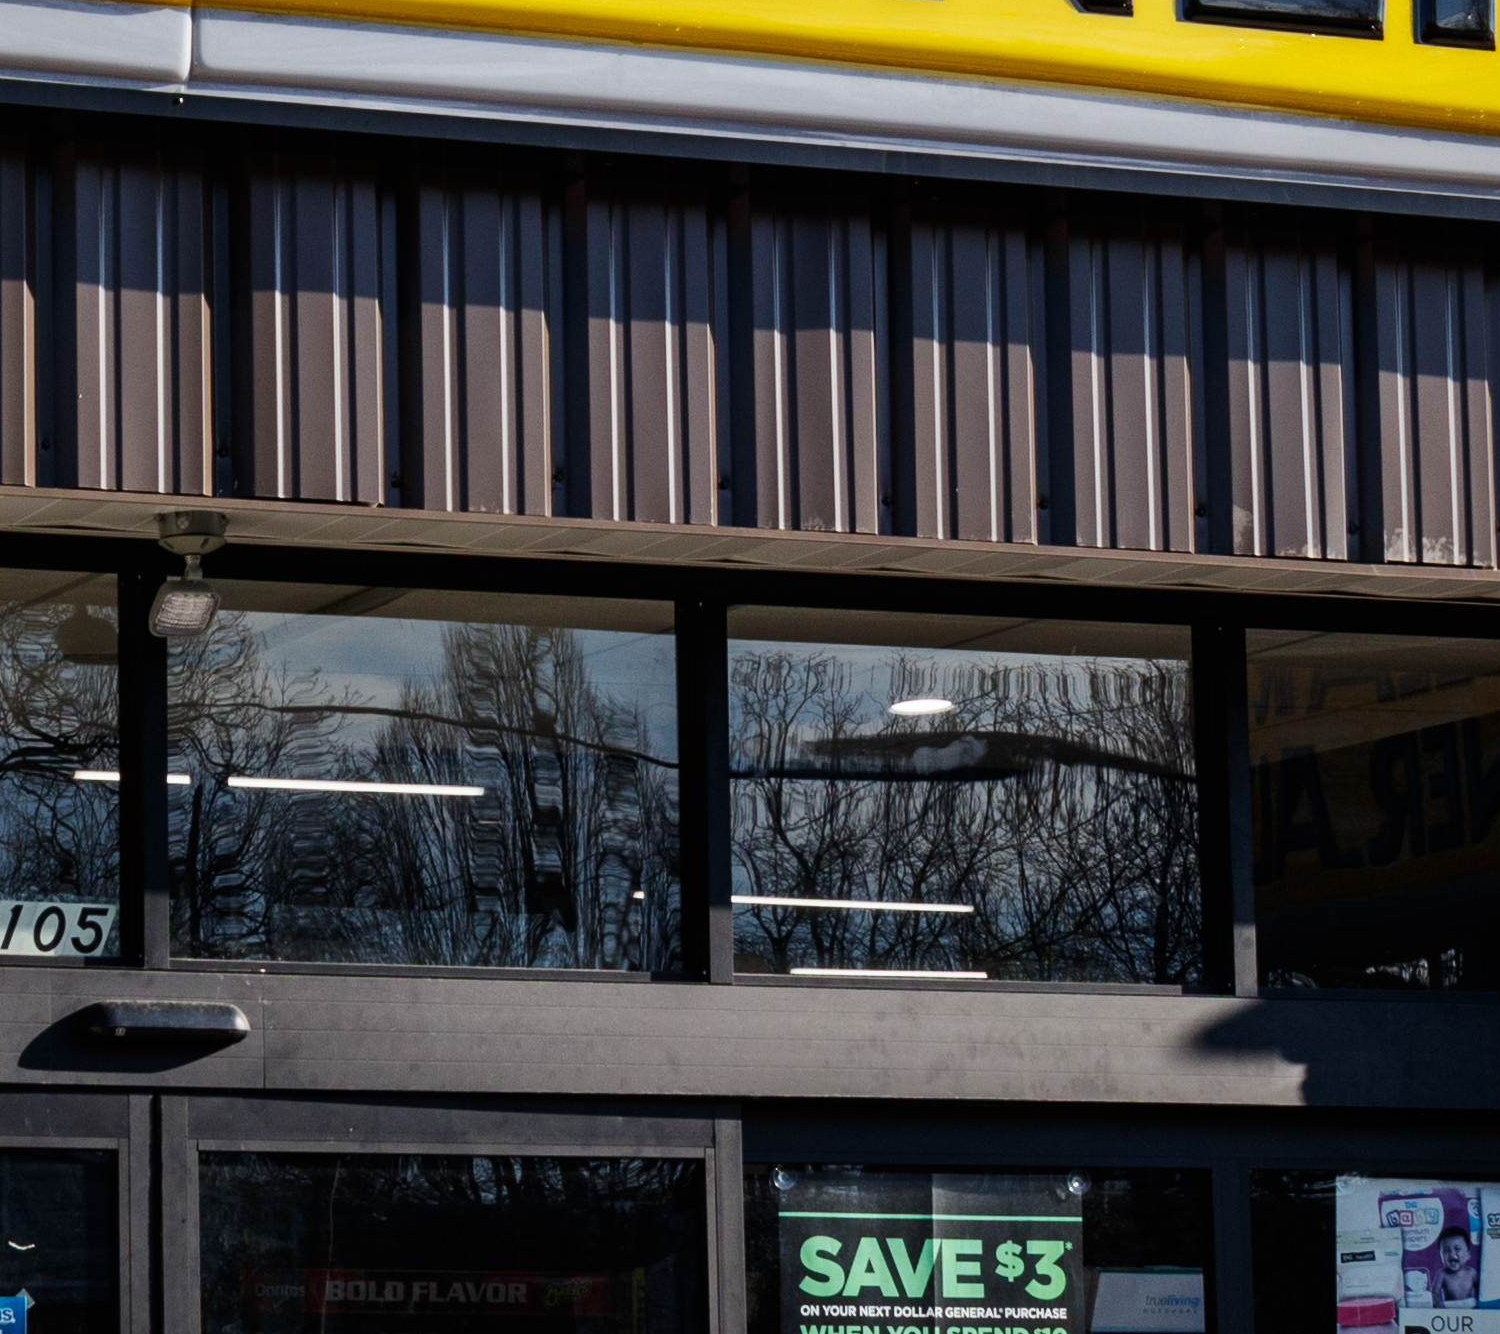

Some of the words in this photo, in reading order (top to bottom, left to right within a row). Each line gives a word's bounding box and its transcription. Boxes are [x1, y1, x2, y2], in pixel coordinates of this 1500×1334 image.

[798, 1235, 985, 1299] SAVE
[325, 1280, 404, 1303] BOLD
[412, 1281, 527, 1303] FLAVOR
[800, 1305, 820, 1316] ON
[822, 1305, 857, 1317] YOUR
[859, 1306, 891, 1317] NEXT
[894, 1306, 943, 1318] DOLLAR
[1004, 1308, 1067, 1319] PURCHASE
[1431, 1315, 1474, 1332] OUR
